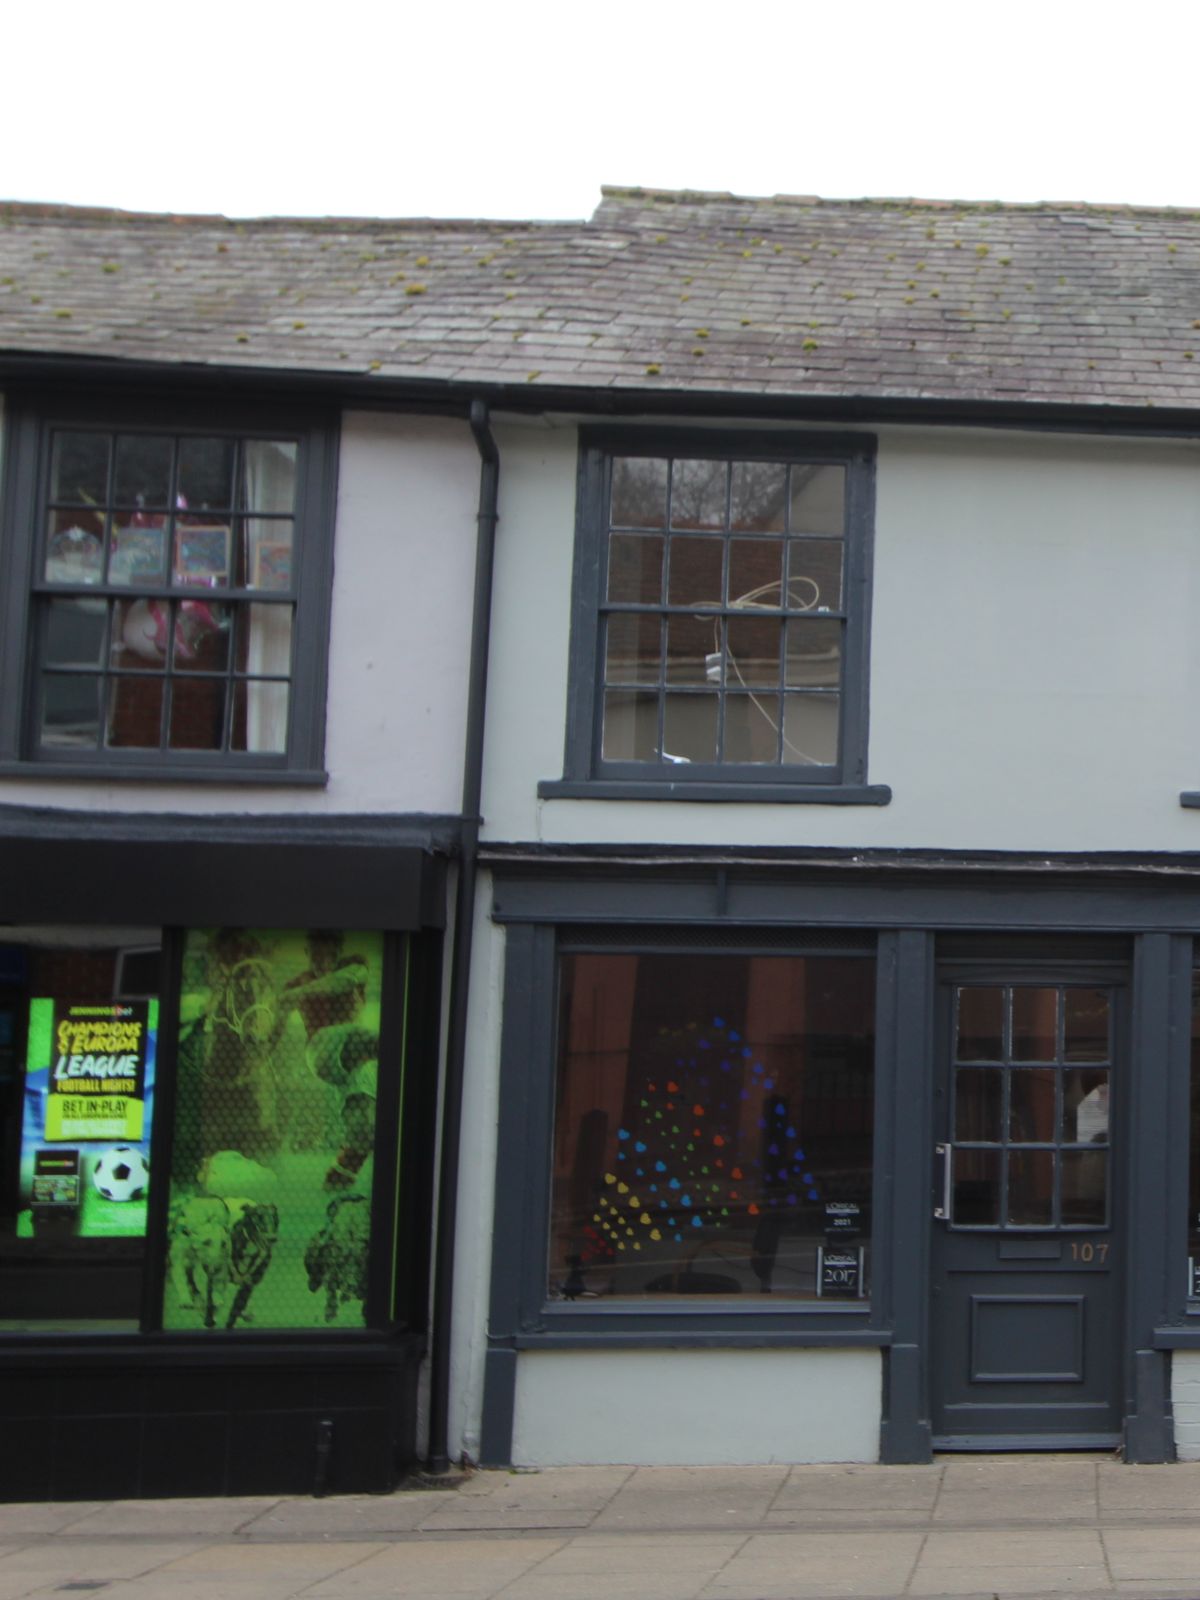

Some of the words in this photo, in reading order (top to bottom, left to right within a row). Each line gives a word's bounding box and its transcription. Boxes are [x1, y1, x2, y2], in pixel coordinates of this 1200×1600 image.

[58, 1020, 142, 1038] CHAMPIONS
[71, 1035, 139, 1055] EUROPA
[54, 1054, 139, 1079] LEAGUE
[57, 1078, 100, 1092] FOOTBALL
[62, 1100, 83, 1111] BET
[86, 1100, 128, 1112] IN-PLAY
[1071, 1242, 1109, 1264] 107
[824, 1269, 857, 1286] 2017
